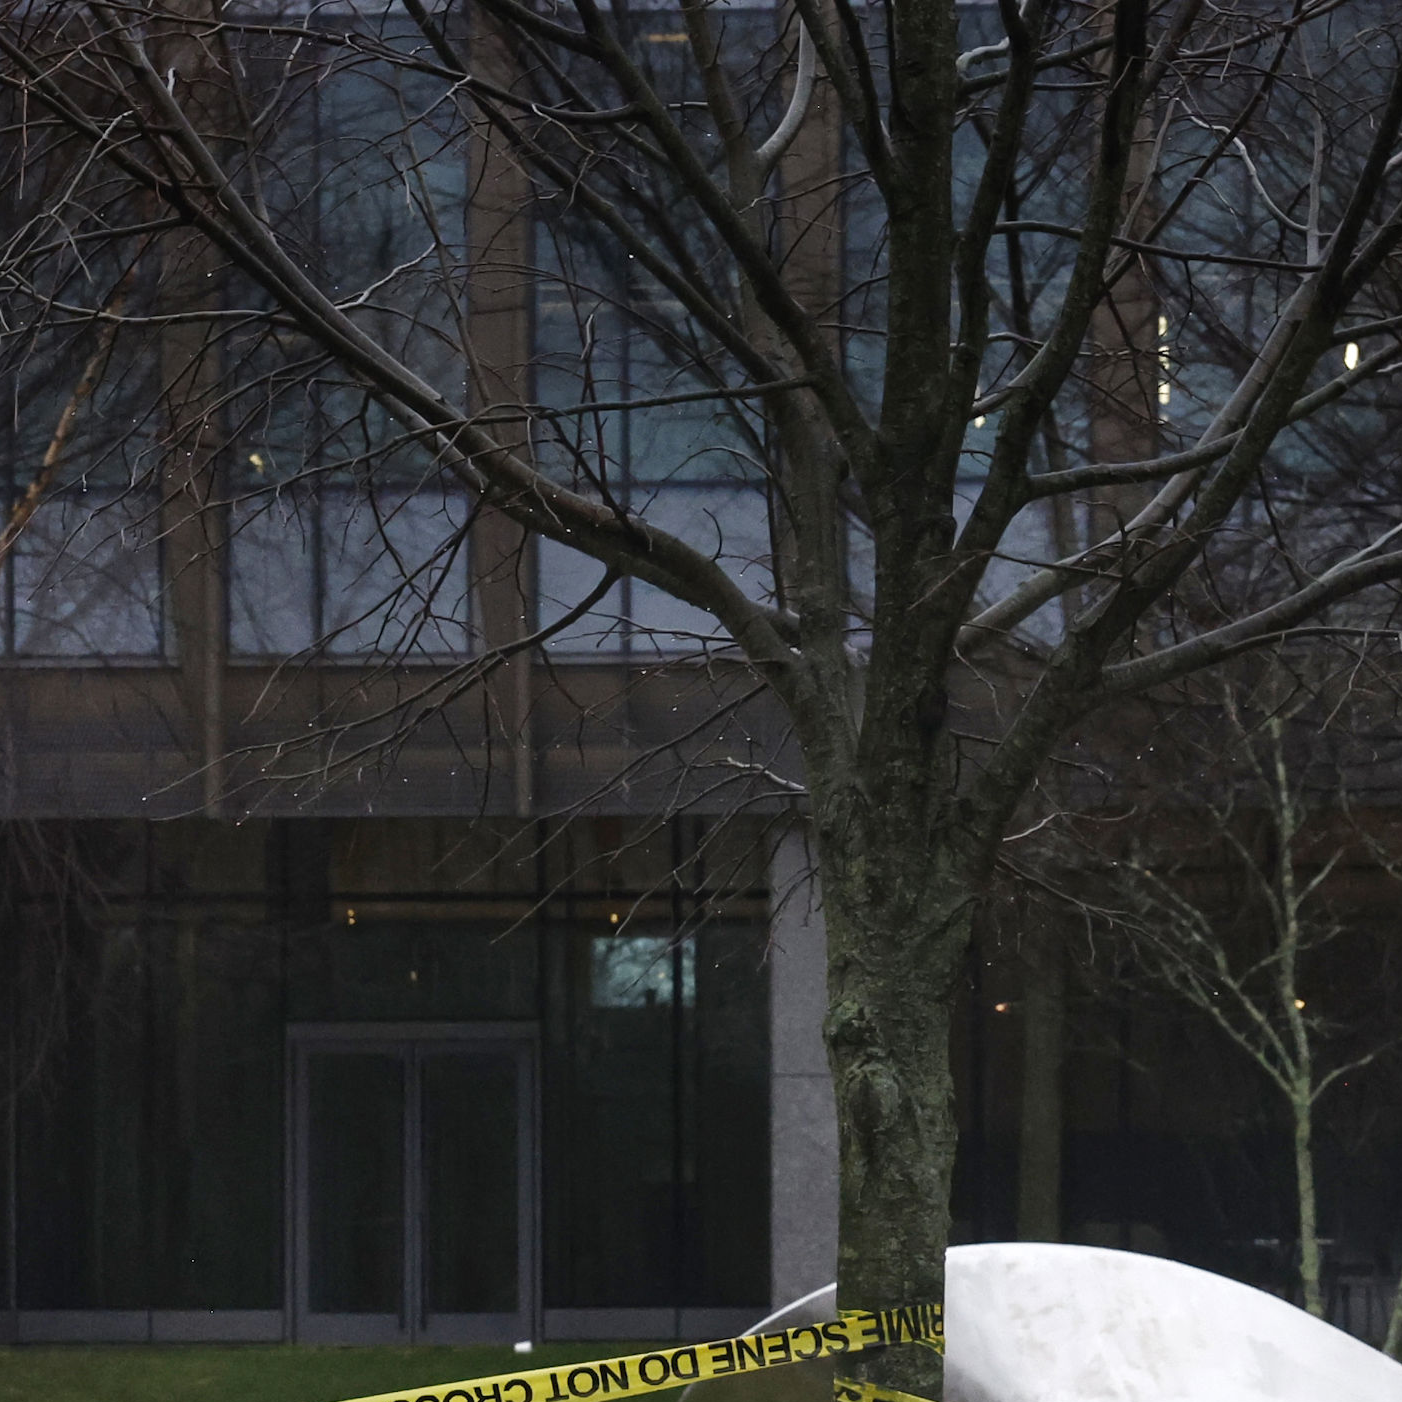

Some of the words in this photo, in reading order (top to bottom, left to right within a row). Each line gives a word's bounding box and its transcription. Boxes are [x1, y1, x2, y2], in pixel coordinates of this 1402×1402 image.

[712, 1319, 849, 1375] SCENE
[858, 1303, 944, 1348] RIME
[547, 1360, 630, 1402] NOT
[640, 1351, 699, 1386] DO
